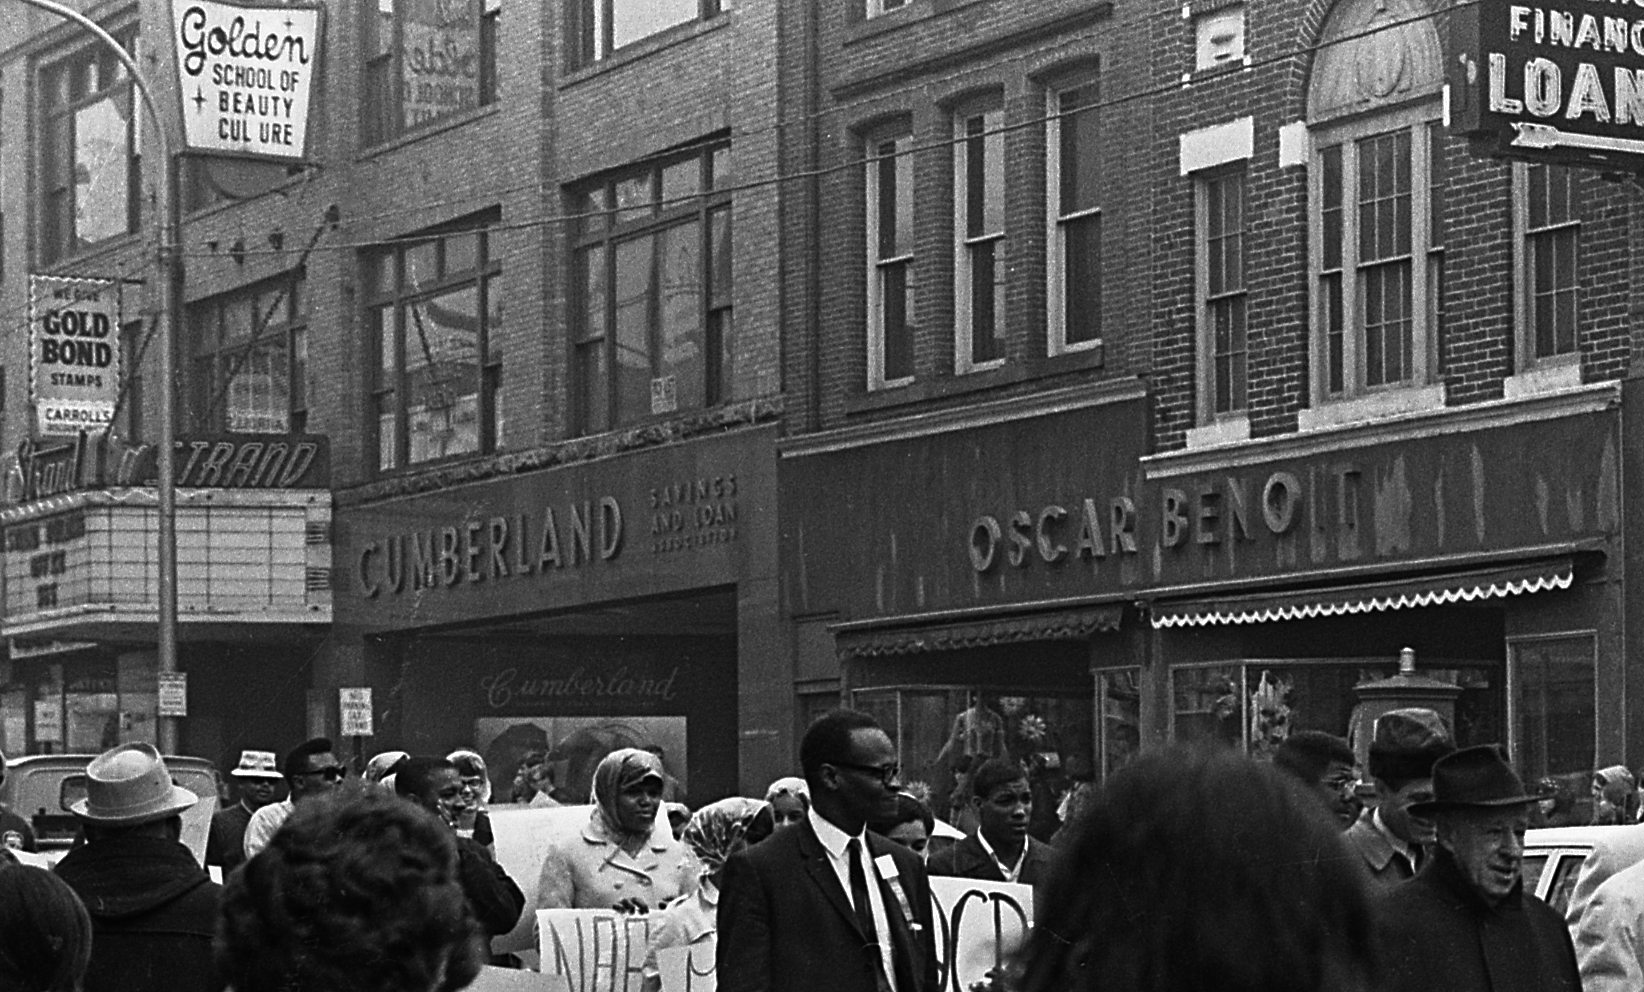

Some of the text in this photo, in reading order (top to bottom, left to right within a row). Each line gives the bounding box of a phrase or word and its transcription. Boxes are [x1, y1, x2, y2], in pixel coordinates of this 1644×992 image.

[181, 6, 309, 76] Golden
[213, 63, 299, 92] SCHOOL OF
[219, 91, 293, 118] BEAUTY
[43, 309, 109, 338] GOLD
[41, 338, 112, 368] BOND
[51, 372, 102, 387] STAMPS
[360, 496, 624, 598] CUMBERLAND
[969, 496, 1138, 572] OSCAR
[481, 667, 678, 708] Cumberland
